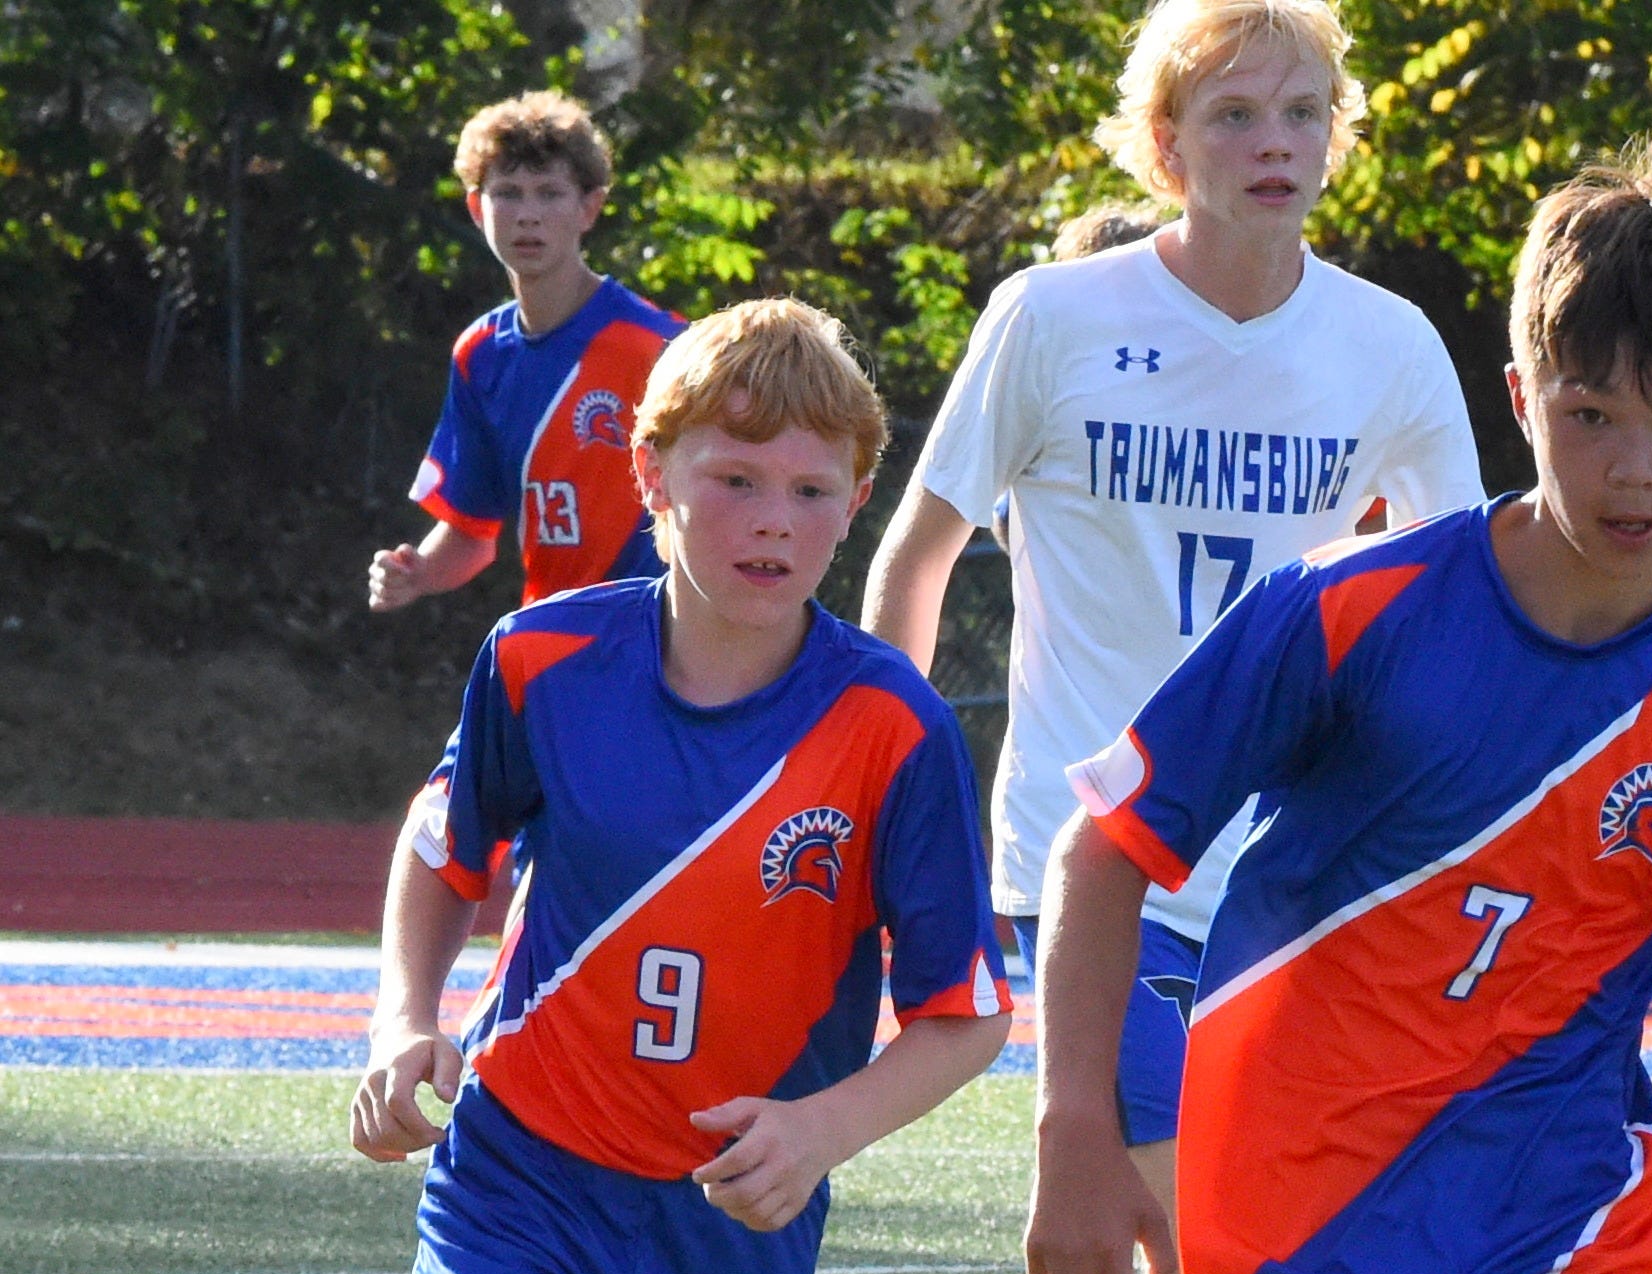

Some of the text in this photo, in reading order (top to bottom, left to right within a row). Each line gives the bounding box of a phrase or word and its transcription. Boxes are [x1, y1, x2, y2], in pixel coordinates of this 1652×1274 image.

[526, 480, 582, 546] 13
[1085, 420, 1359, 514] TRUMANSBURG
[1177, 531, 1254, 636] 17
[1443, 883, 1535, 1001] 7
[632, 943, 705, 1063] 9
